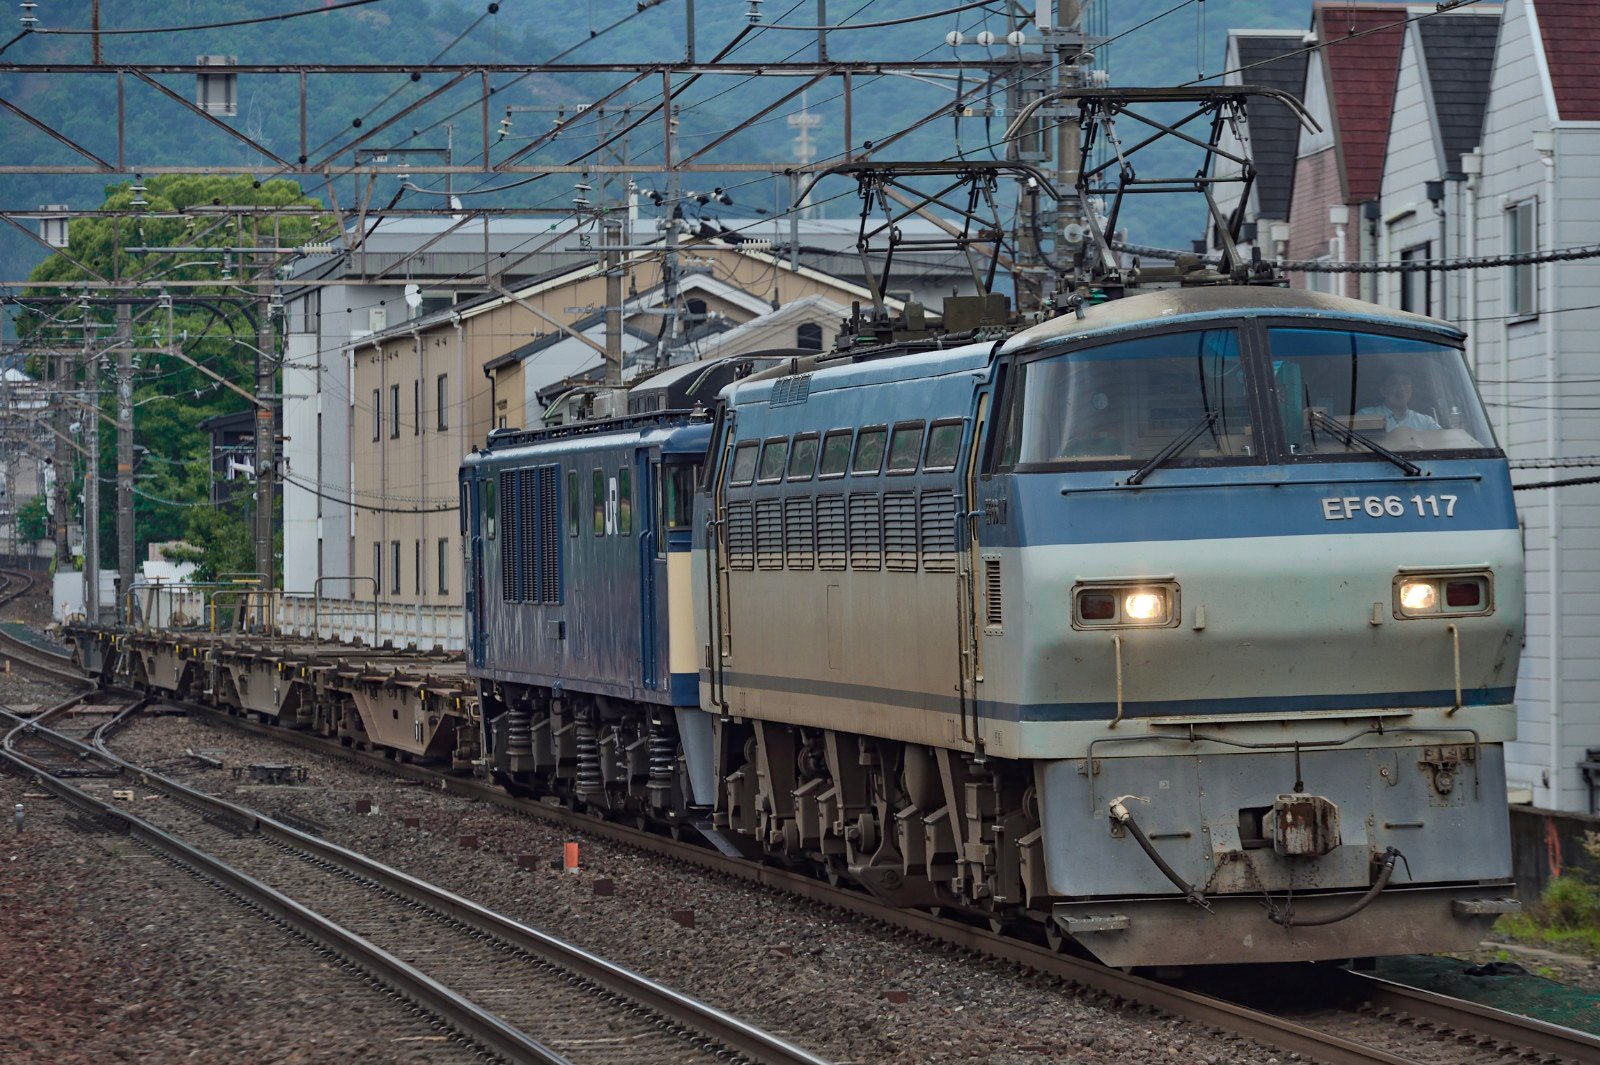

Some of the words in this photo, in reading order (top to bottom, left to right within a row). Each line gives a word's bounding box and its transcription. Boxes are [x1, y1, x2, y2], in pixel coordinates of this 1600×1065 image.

[605, 477, 618, 535] JR
[1321, 495, 1404, 520] EF66
[1410, 494, 1458, 517] 117
